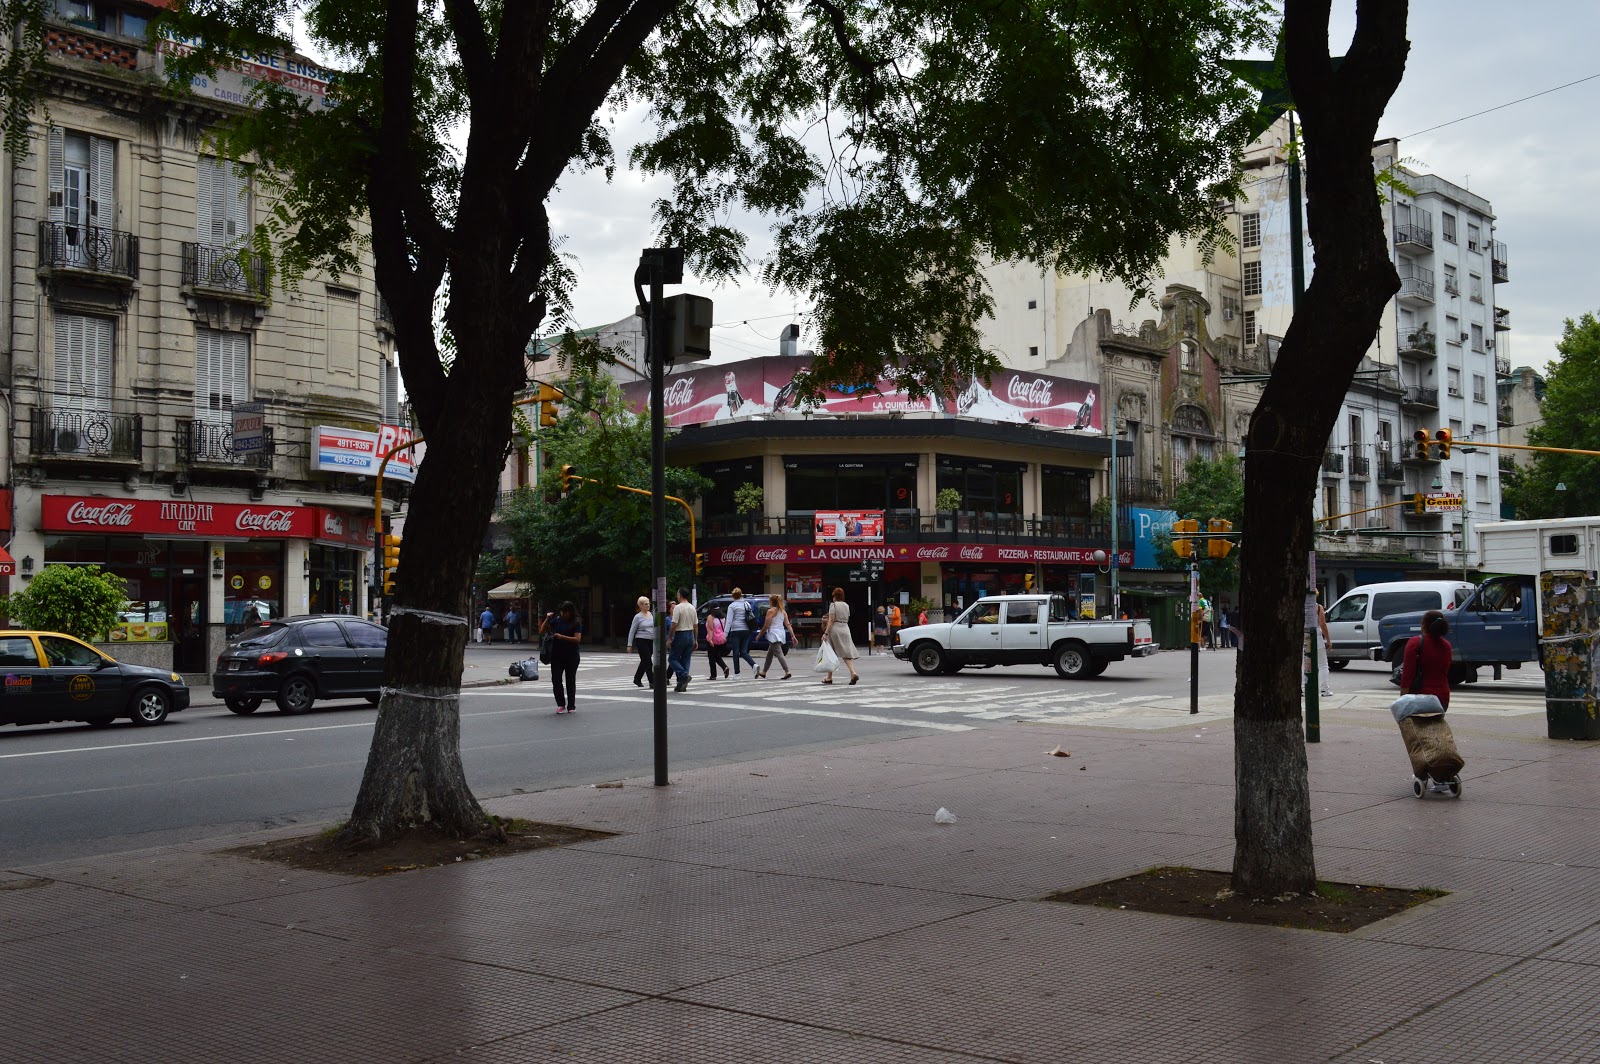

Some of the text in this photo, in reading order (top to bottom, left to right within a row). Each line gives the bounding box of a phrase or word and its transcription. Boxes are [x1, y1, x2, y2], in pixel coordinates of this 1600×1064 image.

[260, 51, 280, 69] DE
[1008, 374, 1053, 405] Coca-Cola
[873, 401, 926, 411] LA QUINTANA
[235, 417, 262, 433] RAUL
[338, 439, 370, 451] 4911-9356
[334, 455, 367, 467] 4943-2526
[66, 501, 137, 526] Coca-Cola
[160, 502, 213, 521] ARABAR
[178, 521, 196, 531] CAFE
[235, 508, 295, 532] Coca-Cola
[721, 548, 746, 562] Coca-Cola
[755, 548, 789, 561] Coca-Cola
[811, 548, 895, 560] LA QUINTANA
[916, 546, 950, 559] Coca-Cola
[960, 545, 983, 560] Coca-Cola
[998, 548, 1029, 560] PIZZERIA
[1033, 549, 1080, 561] RESTAURANTE
[5, 676, 33, 687] Ciudad
